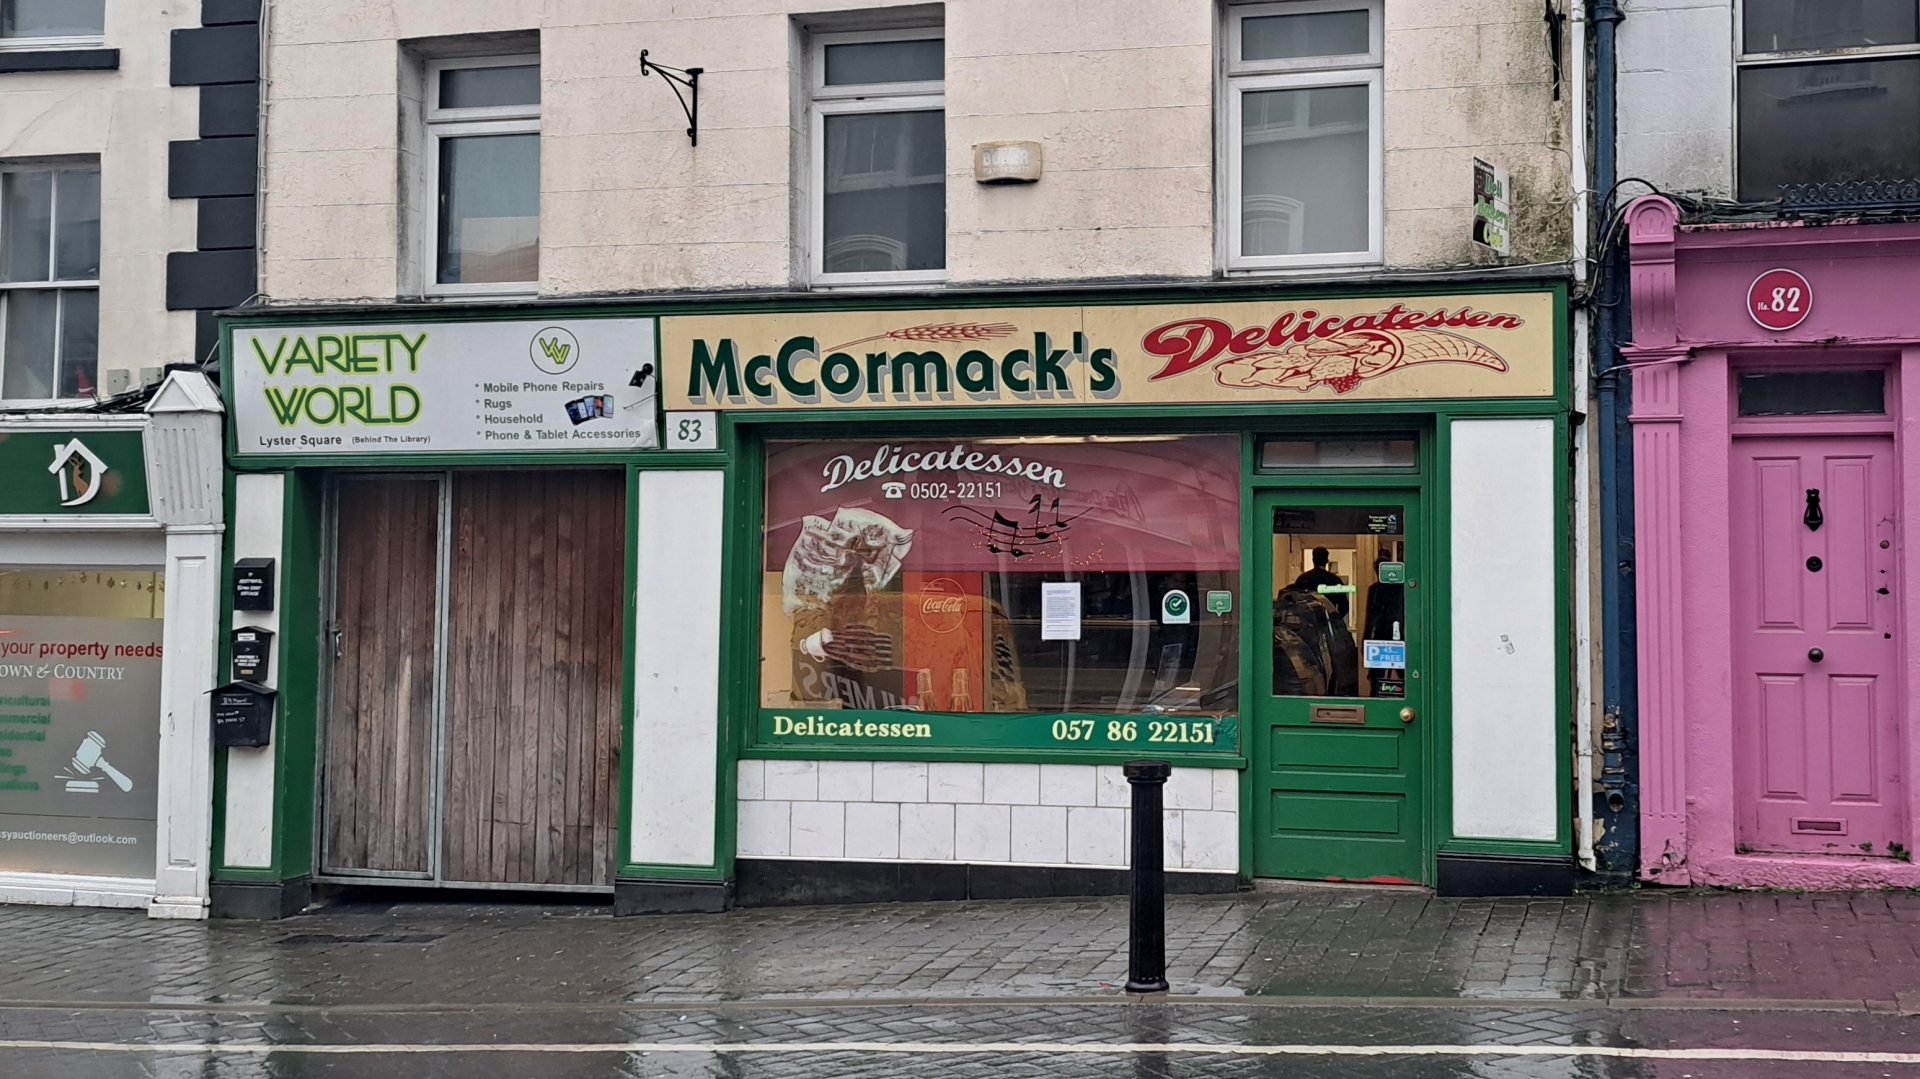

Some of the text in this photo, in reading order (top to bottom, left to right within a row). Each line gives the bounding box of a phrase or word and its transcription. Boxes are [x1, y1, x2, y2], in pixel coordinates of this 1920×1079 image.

[1771, 287, 1801, 312] 82
[252, 331, 429, 376] VARIETY
[1141, 303, 1525, 383] Delicatessen
[687, 331, 1121, 404] McCormack's
[483, 381, 604, 393] Mobile Phone Repairs
[263, 383, 423, 427] WORLD
[484, 399, 512, 410] Rugs
[485, 414, 543, 424] Household
[677, 419, 702, 442] 83
[259, 435, 431, 448] Lyster Square (Behind The Library)
[485, 429, 641, 440] Phone & Tablet Accessories
[820, 444, 1066, 493] Delicatessen
[910, 482, 1001, 498] 0502-22151
[1, 641, 163, 660] your property needs
[36, 663, 51, 679] &
[773, 715, 932, 738] Delicatessen
[1052, 719, 1214, 743] 057 86 22151
